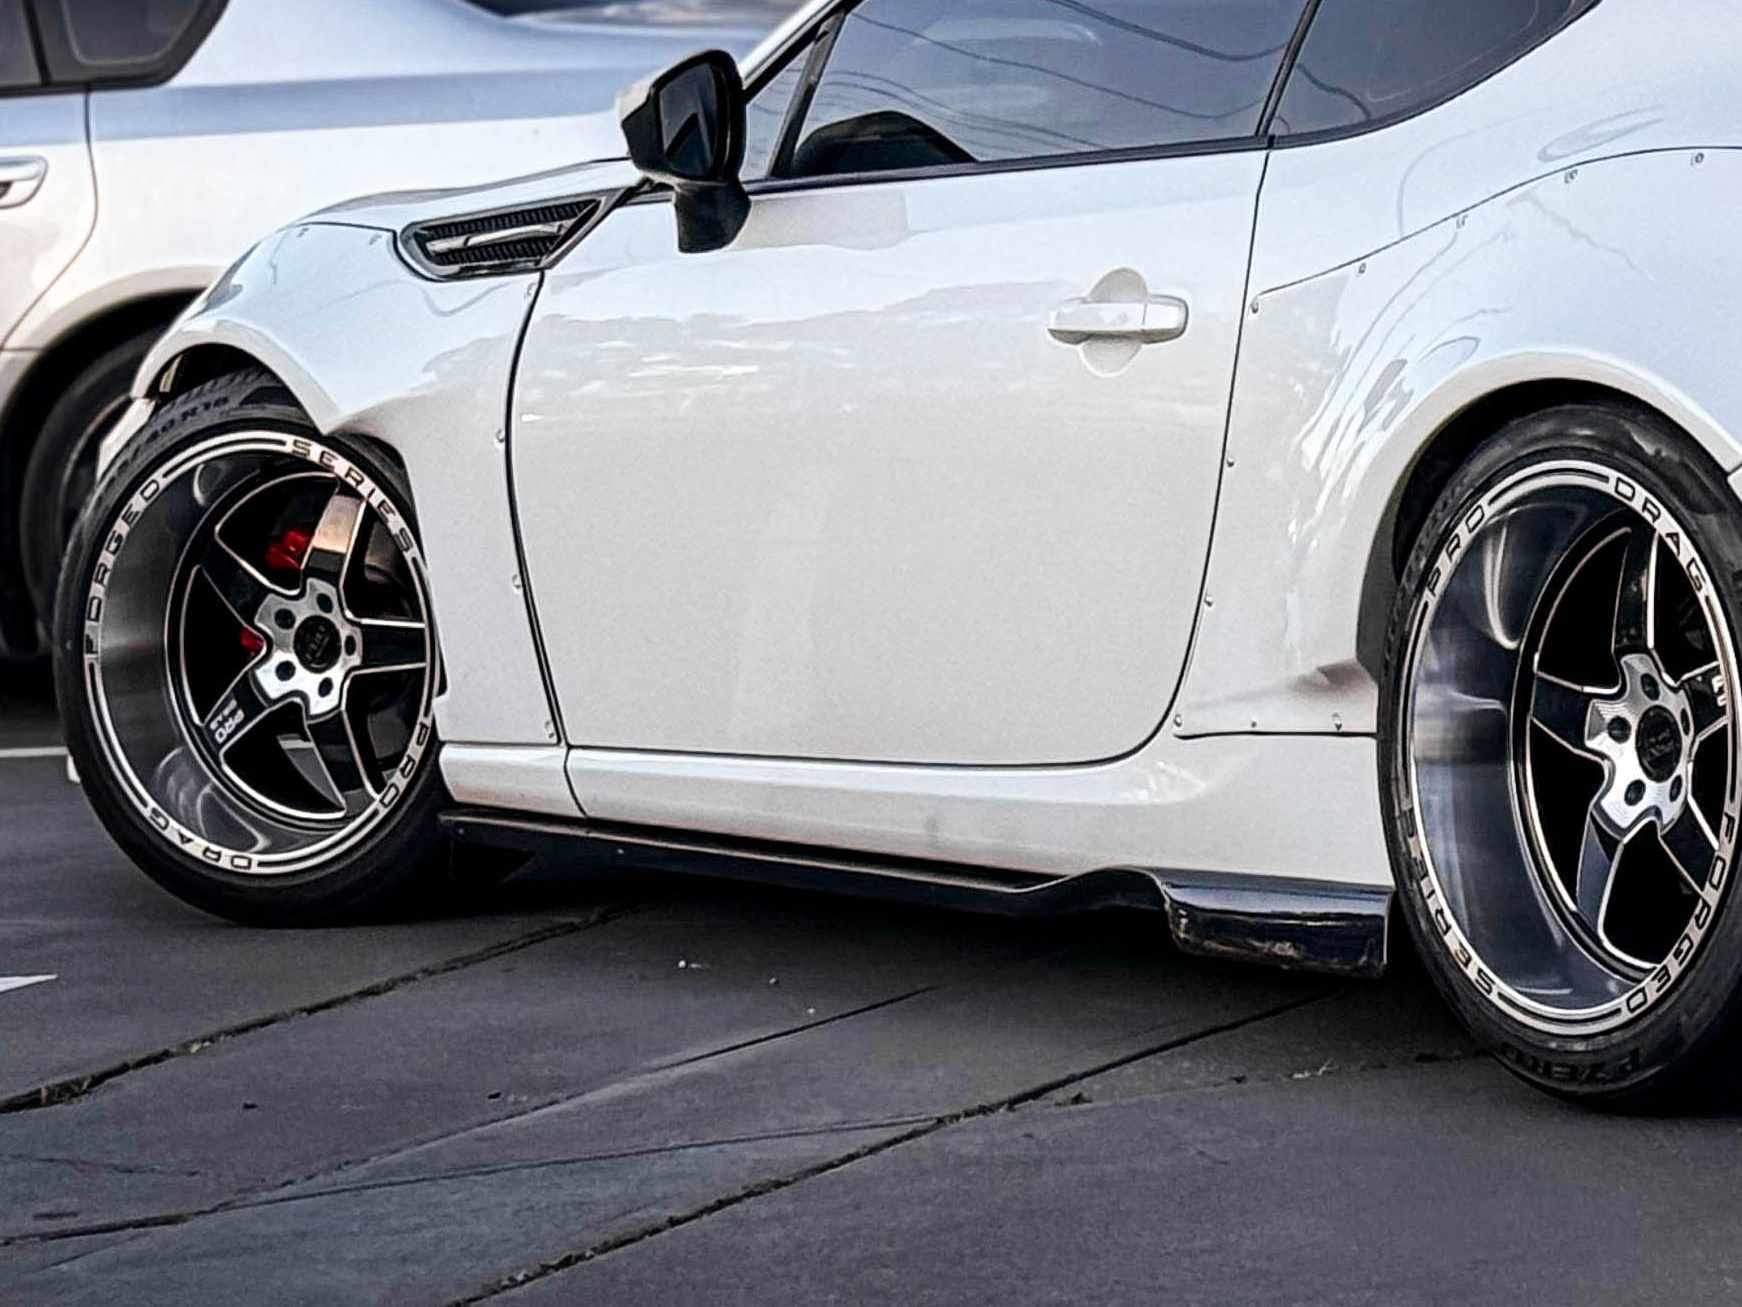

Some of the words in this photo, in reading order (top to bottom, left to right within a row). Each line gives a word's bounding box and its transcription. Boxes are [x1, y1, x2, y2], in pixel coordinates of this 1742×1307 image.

[292, 438, 414, 552] SERIES
[1614, 478, 1709, 590] DRAG
[85, 481, 162, 655] FORGED
[1426, 504, 1487, 600] PRO
[379, 722, 430, 807] PRO
[149, 811, 253, 869] DRAG
[1404, 806, 1495, 995] SERIES
[1626, 815, 1738, 1015] FORGED
